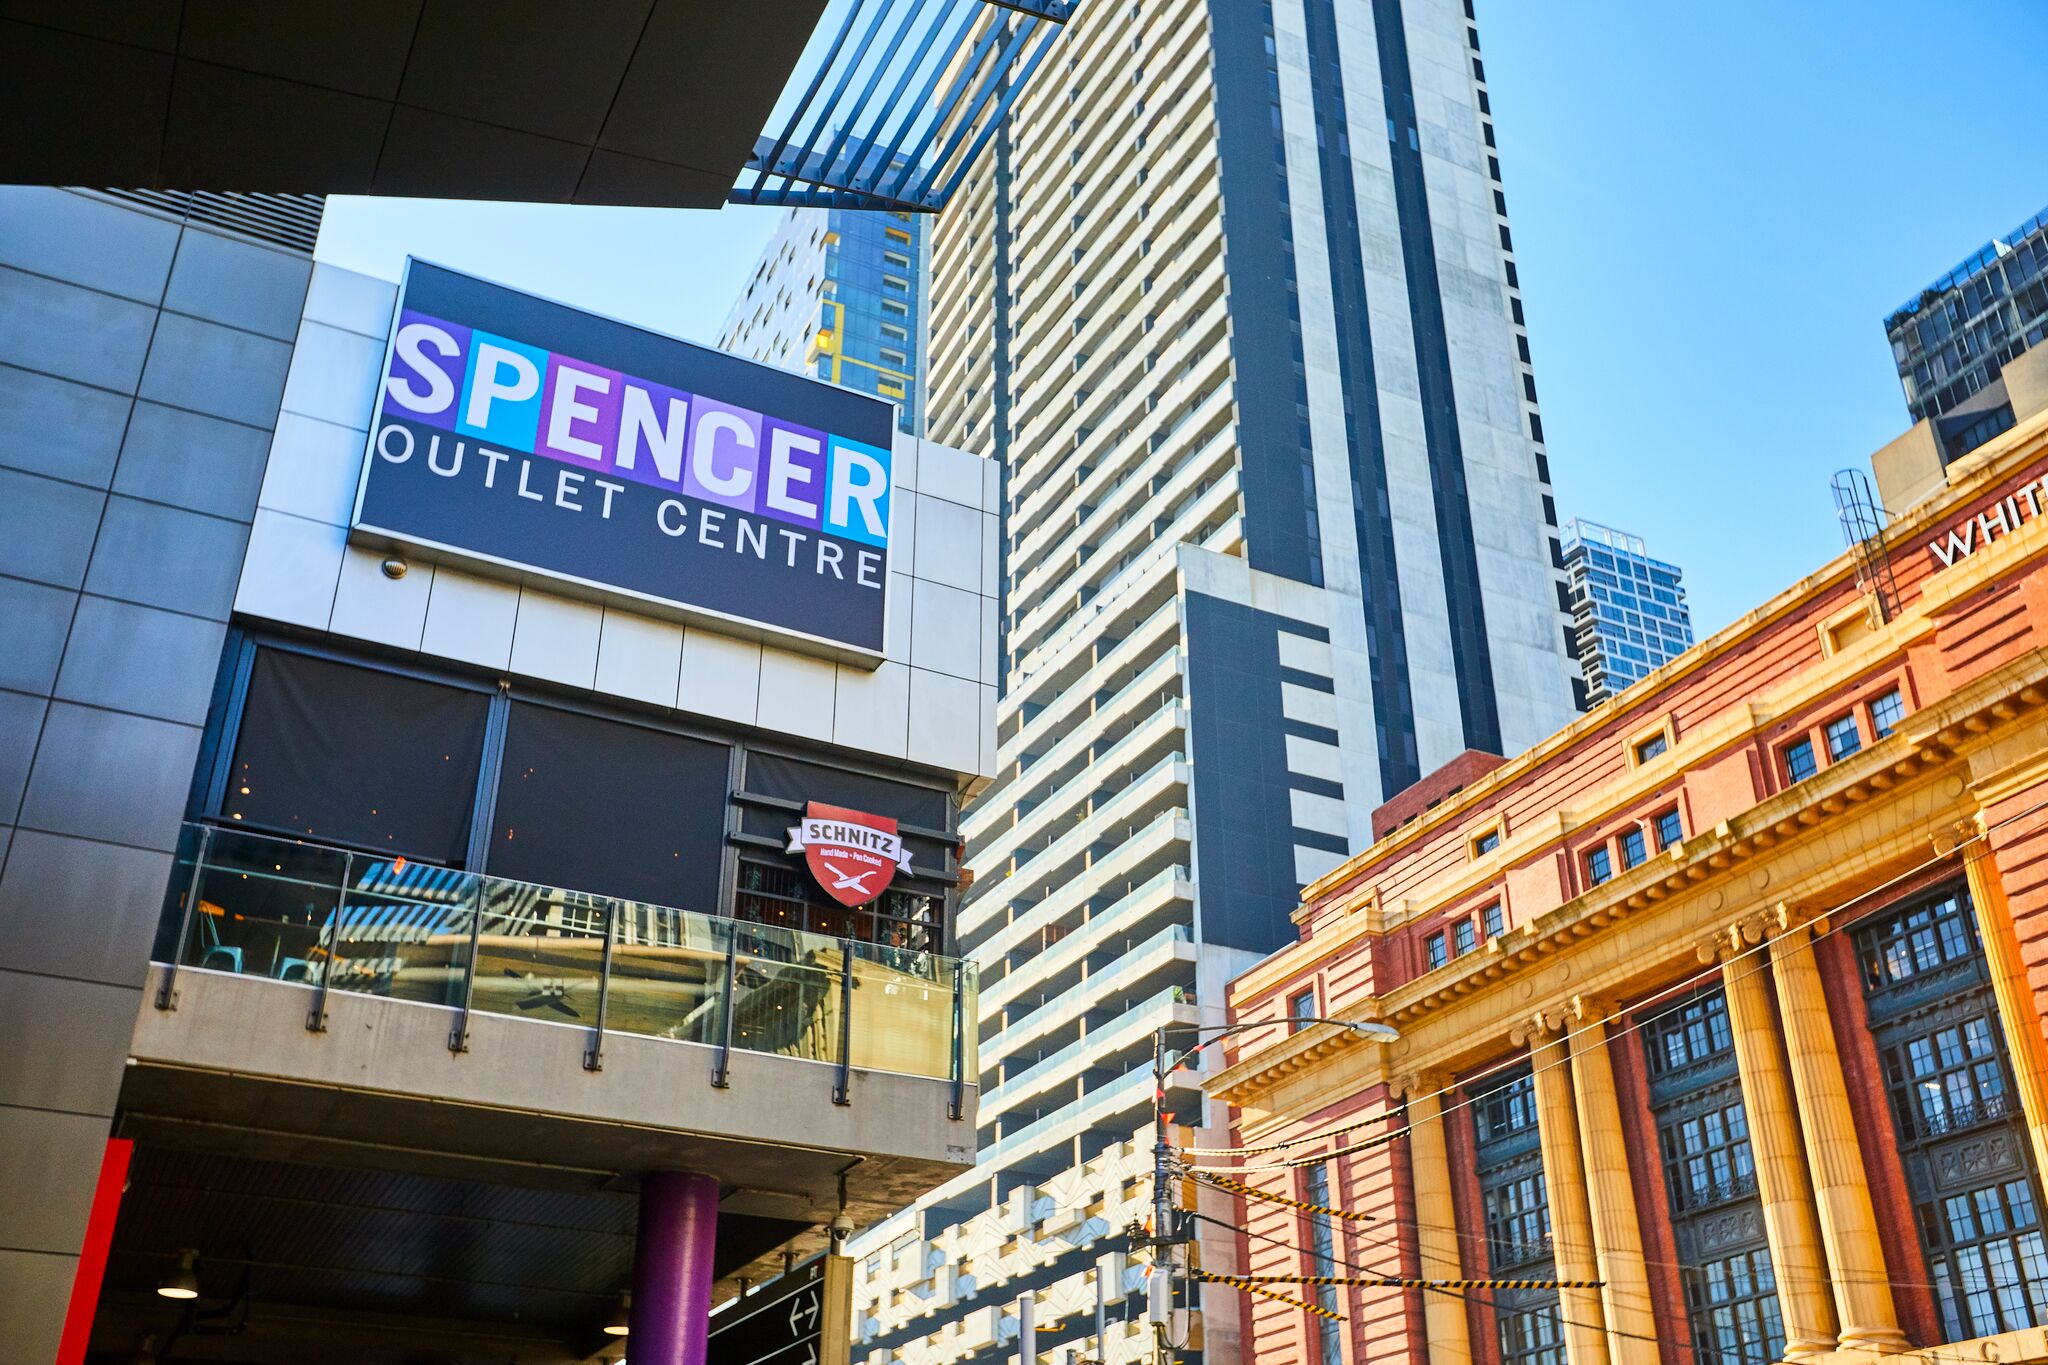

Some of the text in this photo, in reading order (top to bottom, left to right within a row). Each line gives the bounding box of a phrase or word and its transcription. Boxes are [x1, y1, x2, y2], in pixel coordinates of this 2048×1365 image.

[377, 423, 882, 589] OUTLET CENTRE
[387, 322, 888, 538] SPENCER
[809, 823, 894, 853] SCHNITZ
